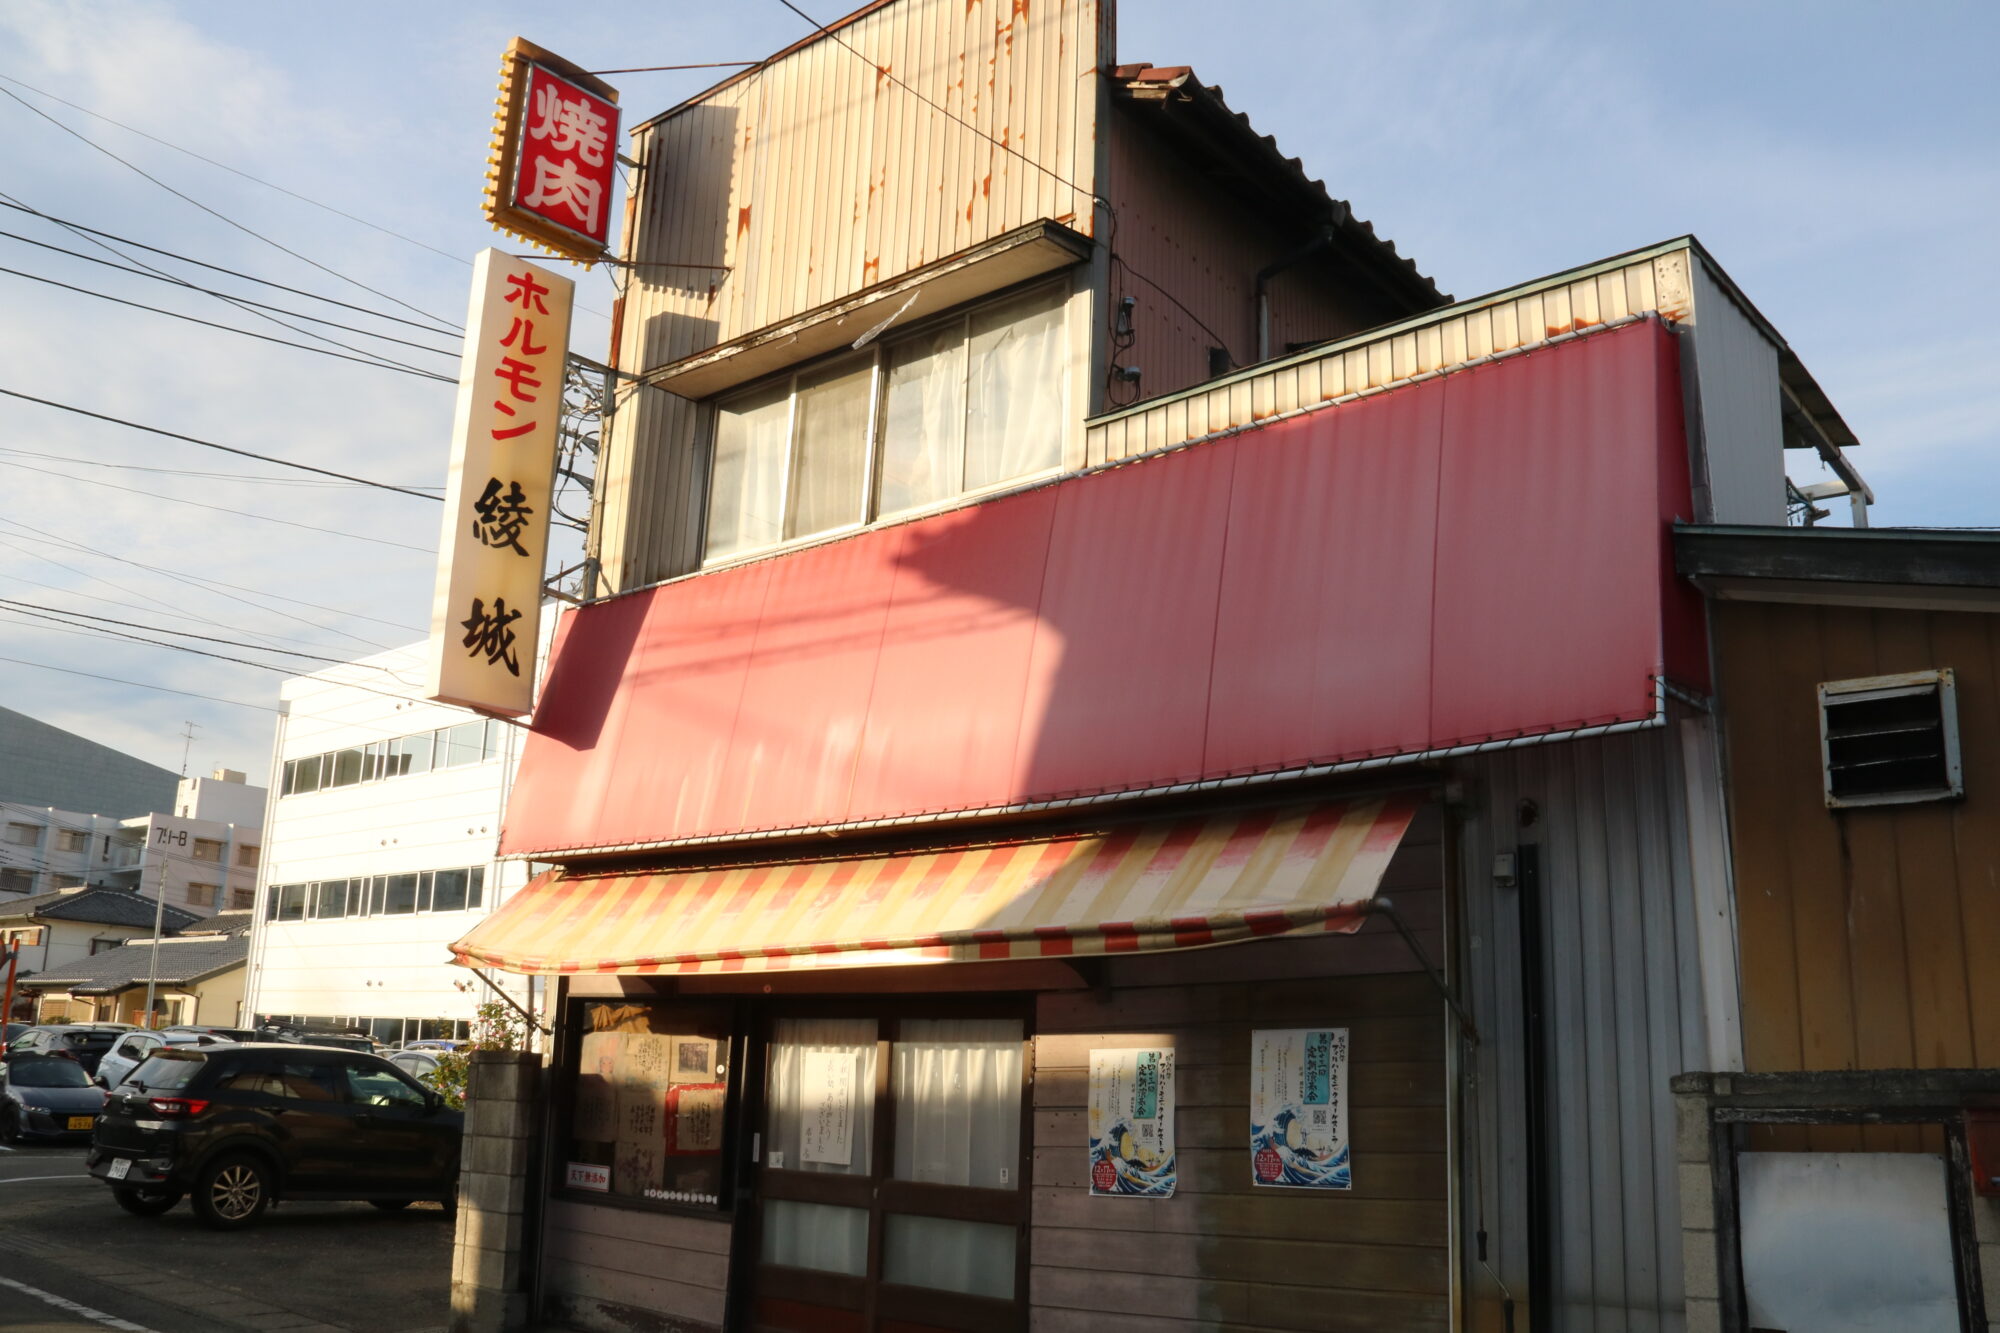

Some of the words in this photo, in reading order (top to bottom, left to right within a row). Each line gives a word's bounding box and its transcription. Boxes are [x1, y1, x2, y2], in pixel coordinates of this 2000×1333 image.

[524, 83, 609, 234] 焼肉
[491, 272, 550, 442] ホルモン
[462, 476, 534, 679] 綾城
